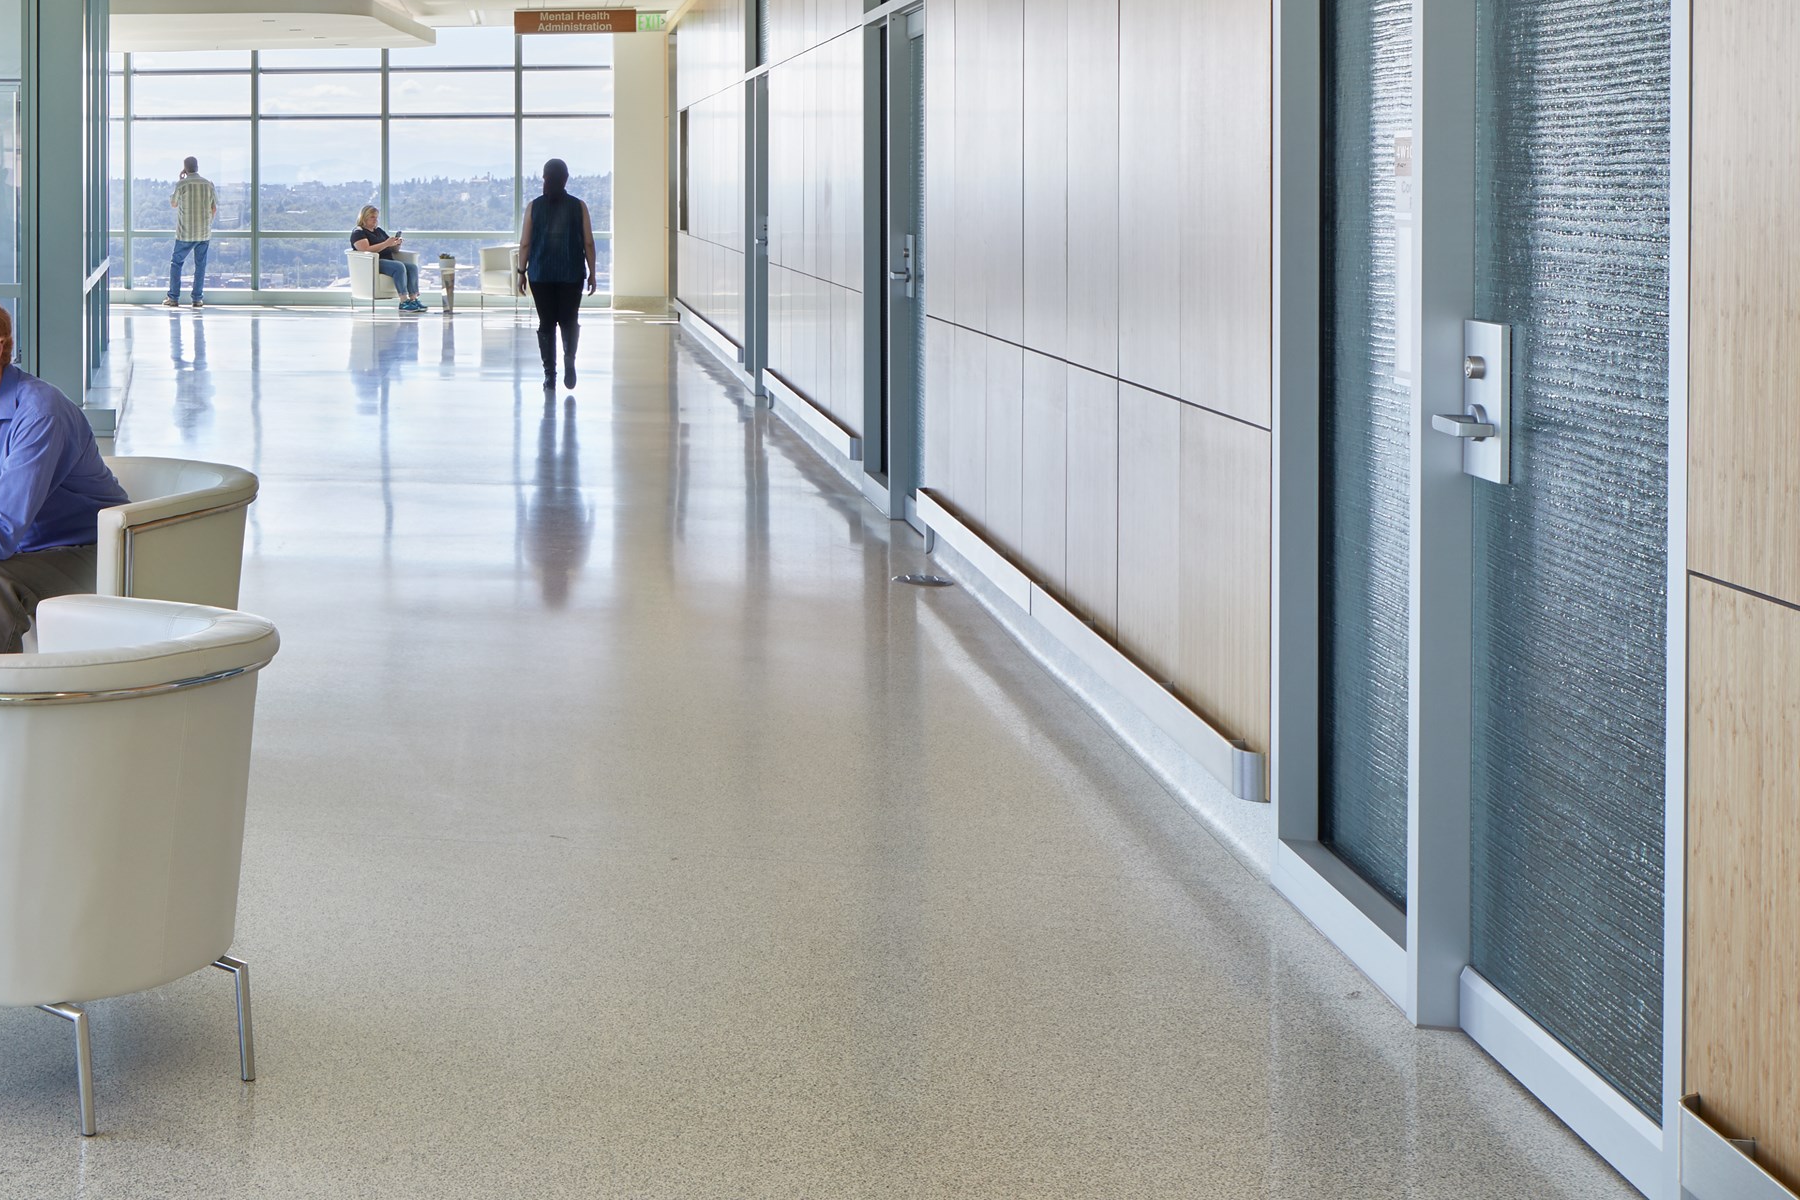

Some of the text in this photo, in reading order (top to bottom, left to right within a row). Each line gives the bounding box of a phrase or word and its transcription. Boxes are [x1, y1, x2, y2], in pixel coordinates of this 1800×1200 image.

[540, 11, 610, 21] Mental Health
[537, 22, 612, 32] Administration
[638, 14, 661, 31] EXIT
